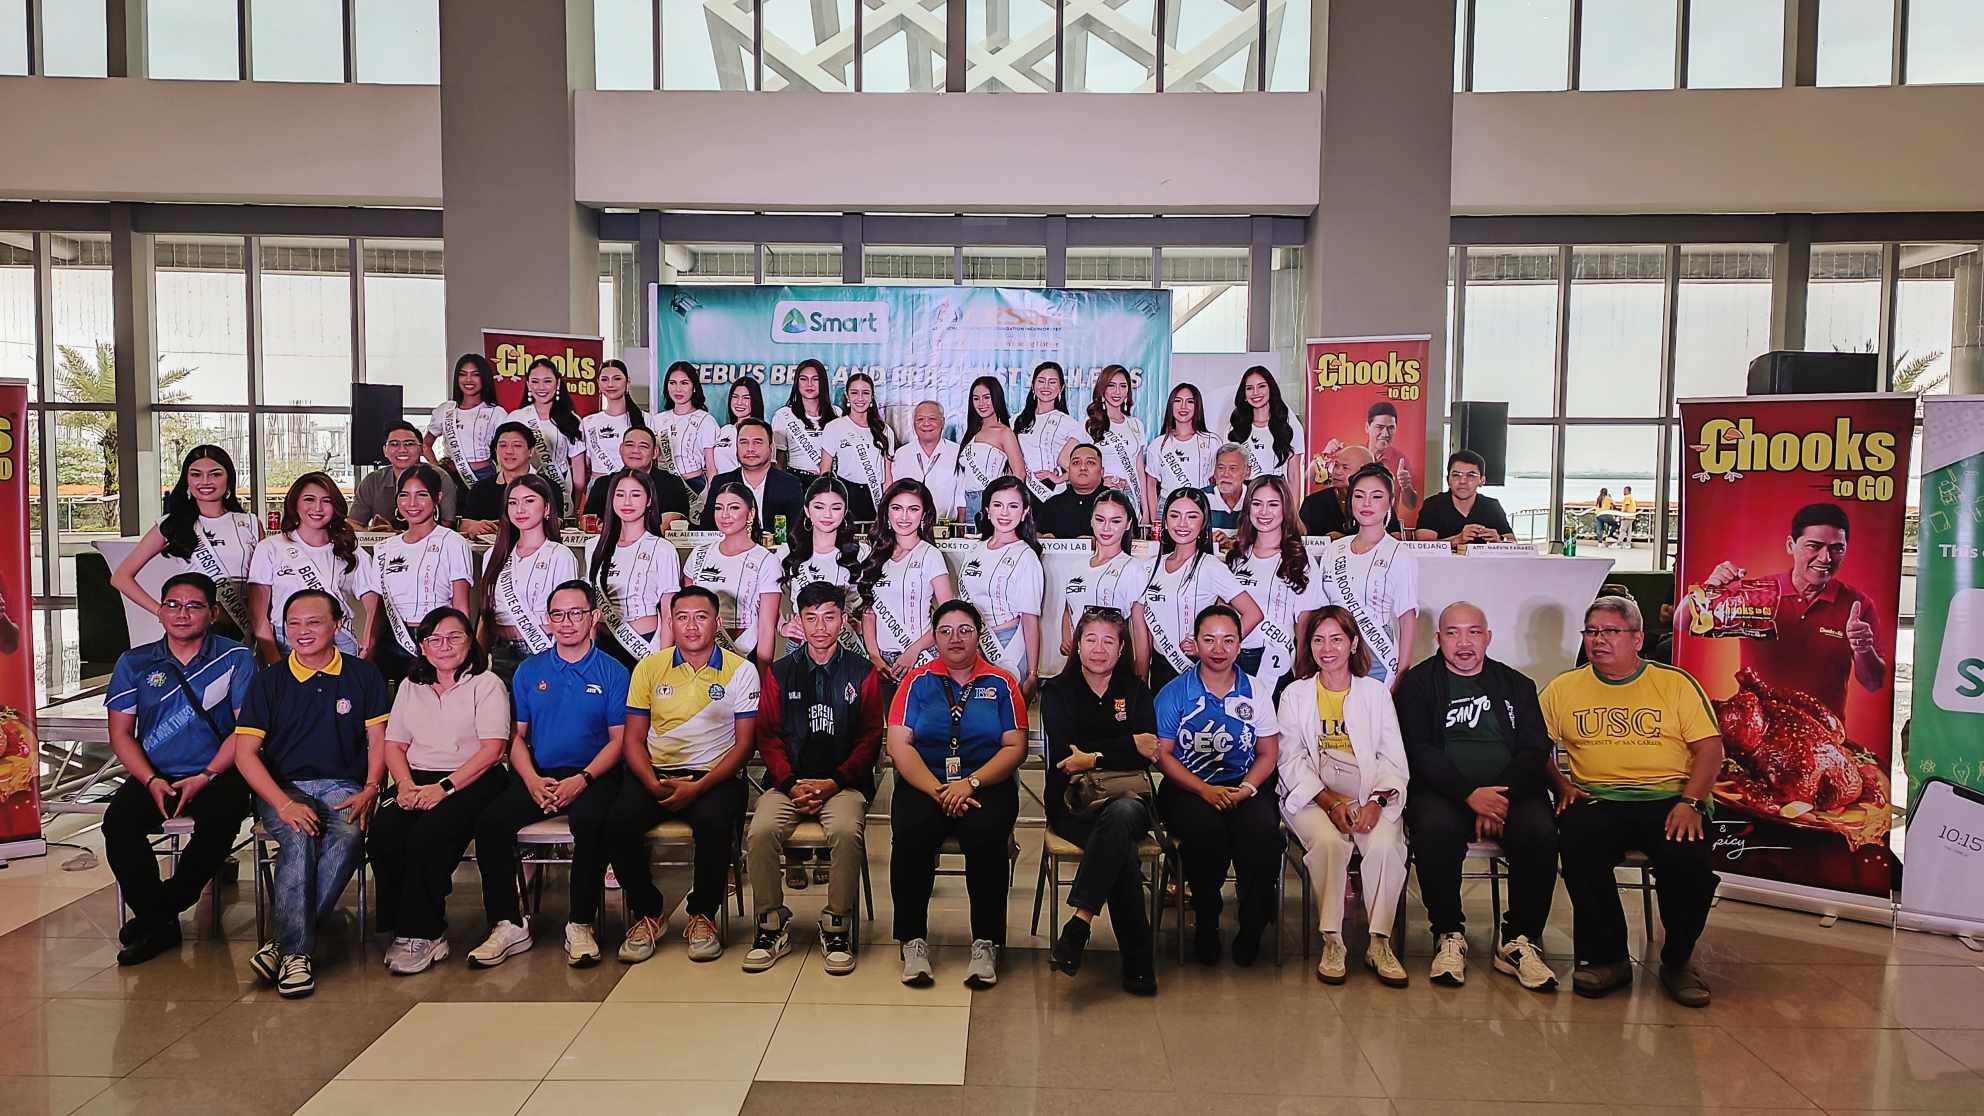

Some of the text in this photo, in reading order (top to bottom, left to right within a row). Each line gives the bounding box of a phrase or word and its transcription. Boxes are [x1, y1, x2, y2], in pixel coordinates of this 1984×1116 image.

[809, 310, 877, 335] Smart
[693, 363, 765, 385] EBU'S
[1317, 352, 1421, 386] Chooks
[578, 381, 595, 396] GO
[1388, 385, 1420, 400] to GO
[788, 421, 800, 437] CEBU
[1699, 417, 1896, 474] Chooks
[541, 453, 552, 463] OF
[1832, 476, 1894, 501] to GO
[1335, 555, 1347, 577] CEBU
[215, 577, 230, 589] OF
[1337, 575, 1365, 618] ROOSVELT
[512, 605, 523, 616] OF
[602, 603, 612, 615] OF
[875, 600, 904, 637] DOCTORS
[516, 615, 550, 652] TECHNOLO
[606, 613, 621, 631] SAN
[617, 625, 636, 644] JOSE
[1152, 624, 1164, 637] OF
[1160, 636, 1173, 654] THE
[1358, 614, 1391, 660] MEMORIAL
[981, 631, 1002, 662] VISAYAS
[1271, 655, 1281, 669] 2
[1573, 708, 1662, 738] USC
[1179, 728, 1234, 753] CEC
[1720, 824, 1727, 832] &
[1938, 825, 1984, 852] 10:15
